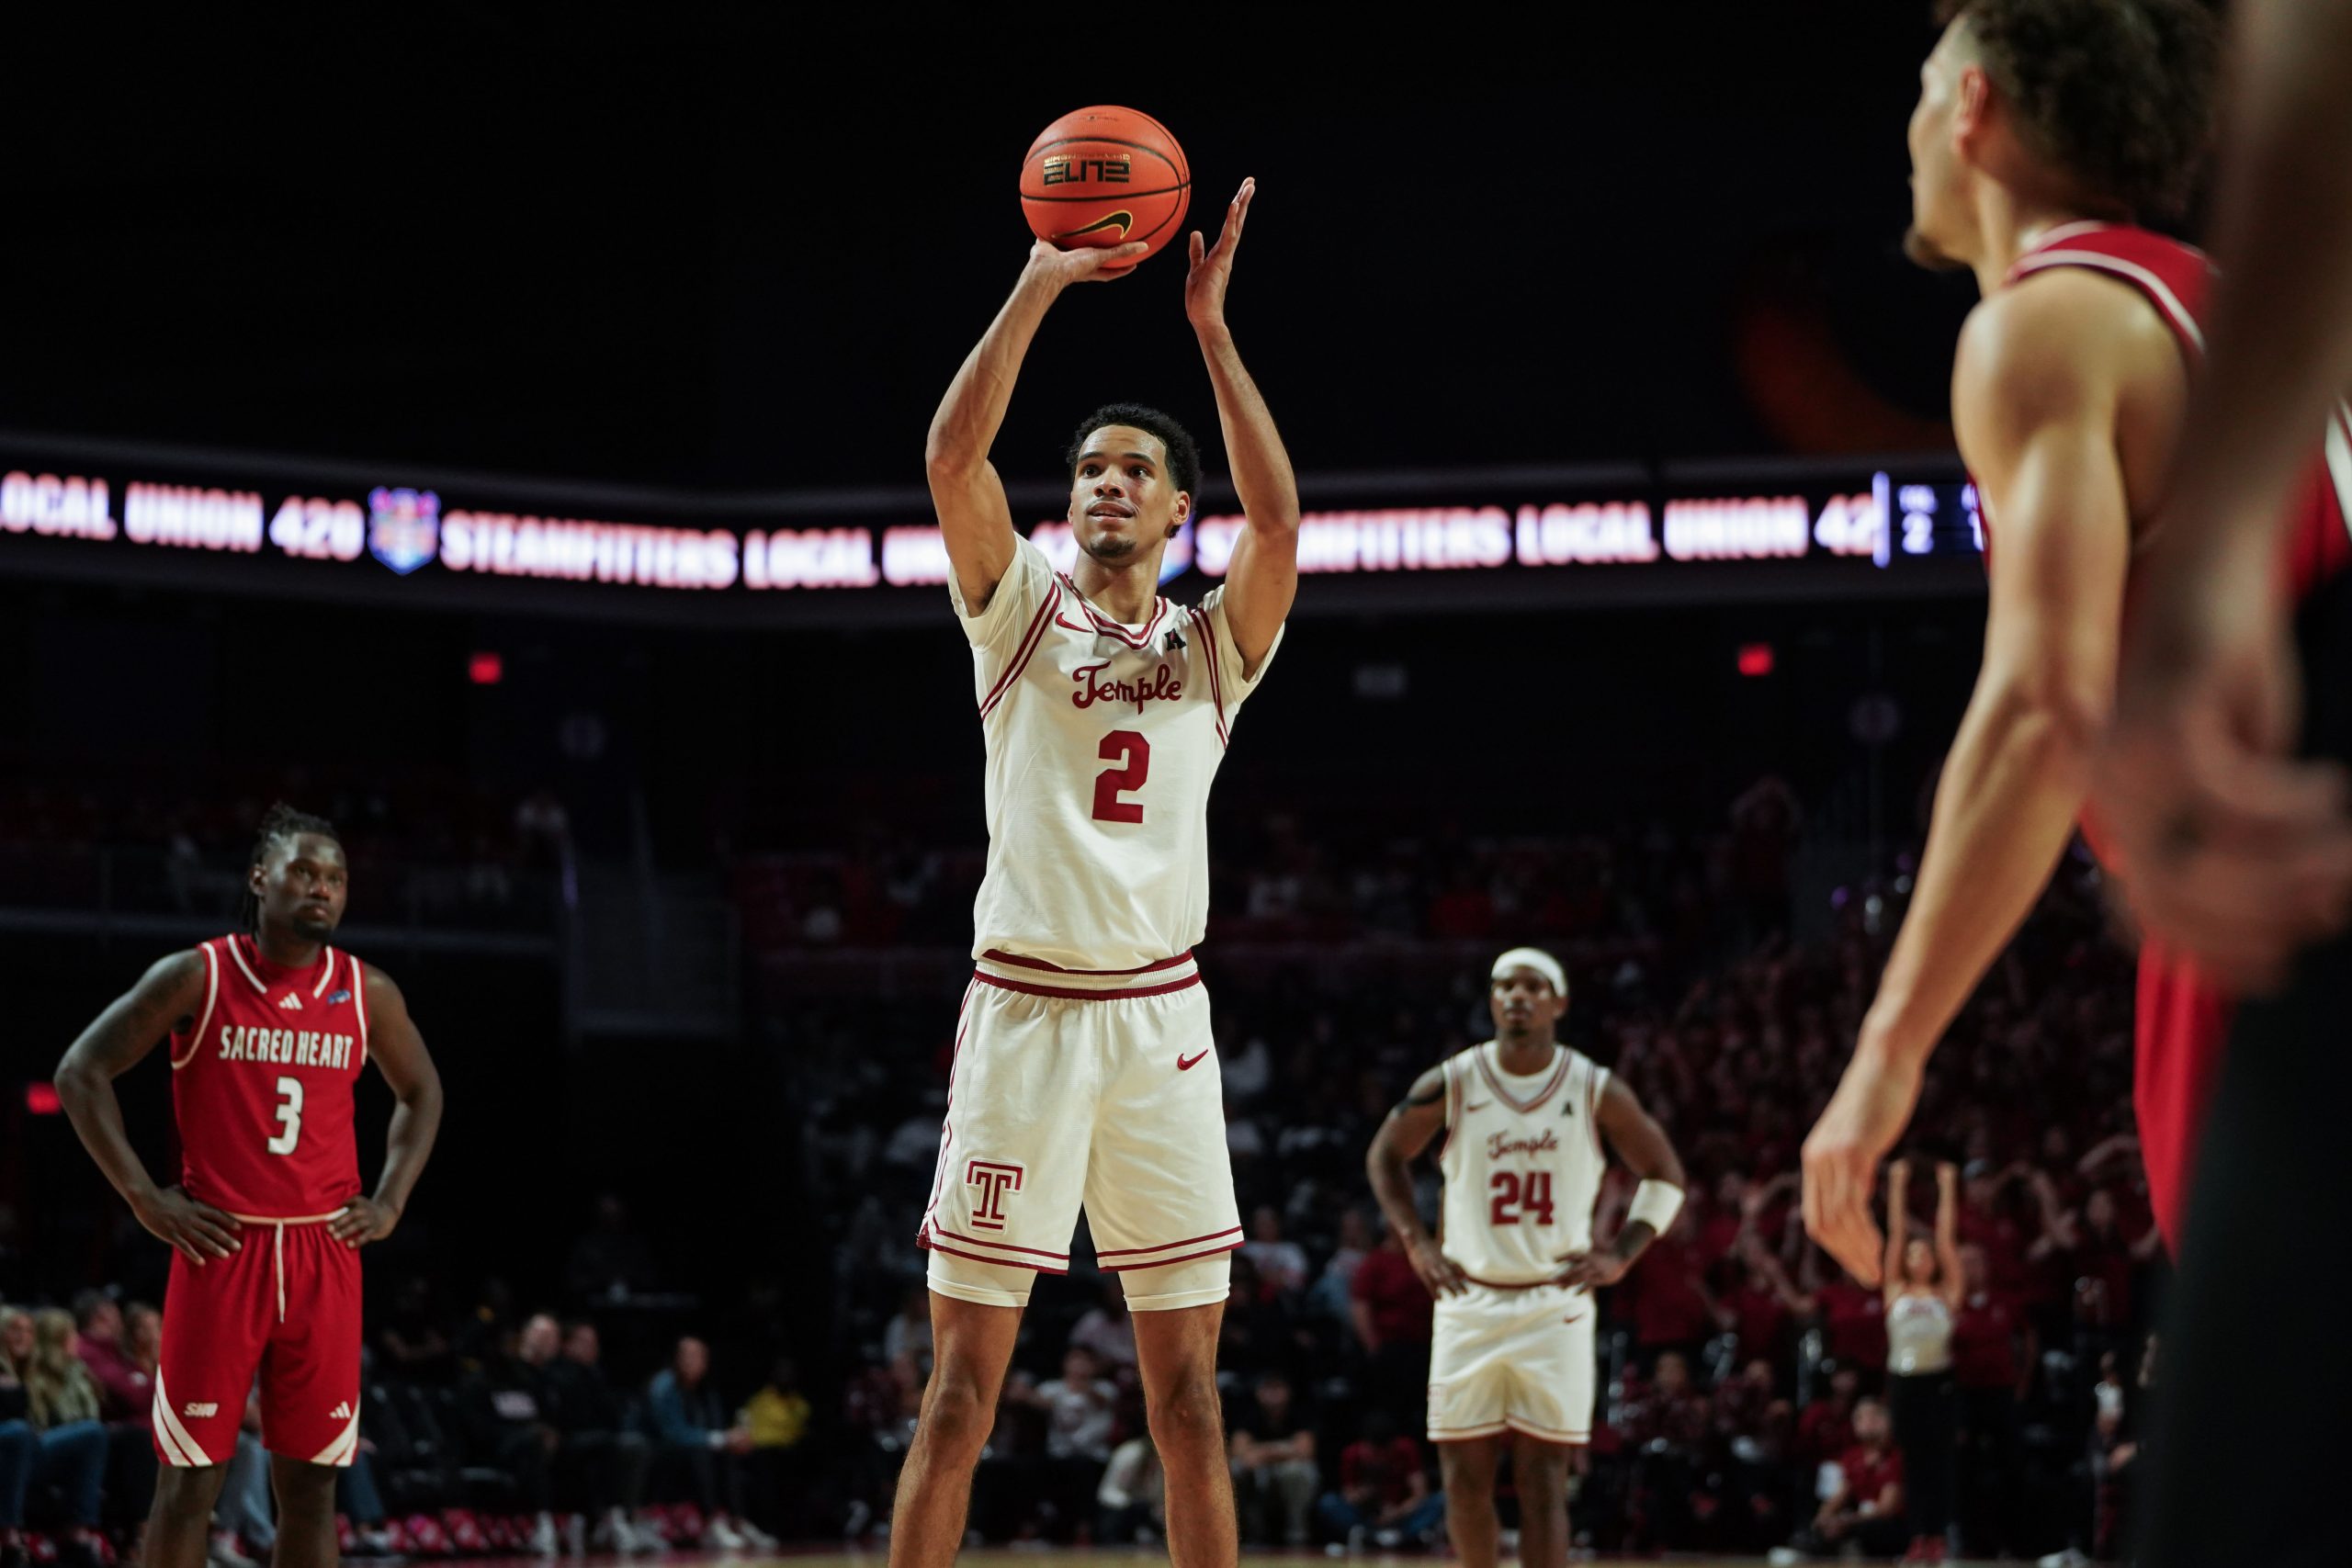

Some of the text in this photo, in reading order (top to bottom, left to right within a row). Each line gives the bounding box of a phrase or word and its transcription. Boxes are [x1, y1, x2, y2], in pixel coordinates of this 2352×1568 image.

[1044, 159, 1130, 186] ELITE
[0, 470, 118, 541] OCAL
[269, 495, 366, 561] 420
[1072, 660, 1182, 716] Temple
[1092, 730, 1150, 824] 2
[219, 1025, 353, 1071] SACRED HEART
[267, 1076, 303, 1156] 3
[1487, 1128, 1558, 1160] Temple
[966, 1160, 1023, 1230] T
[1489, 1170, 1555, 1226] 24
